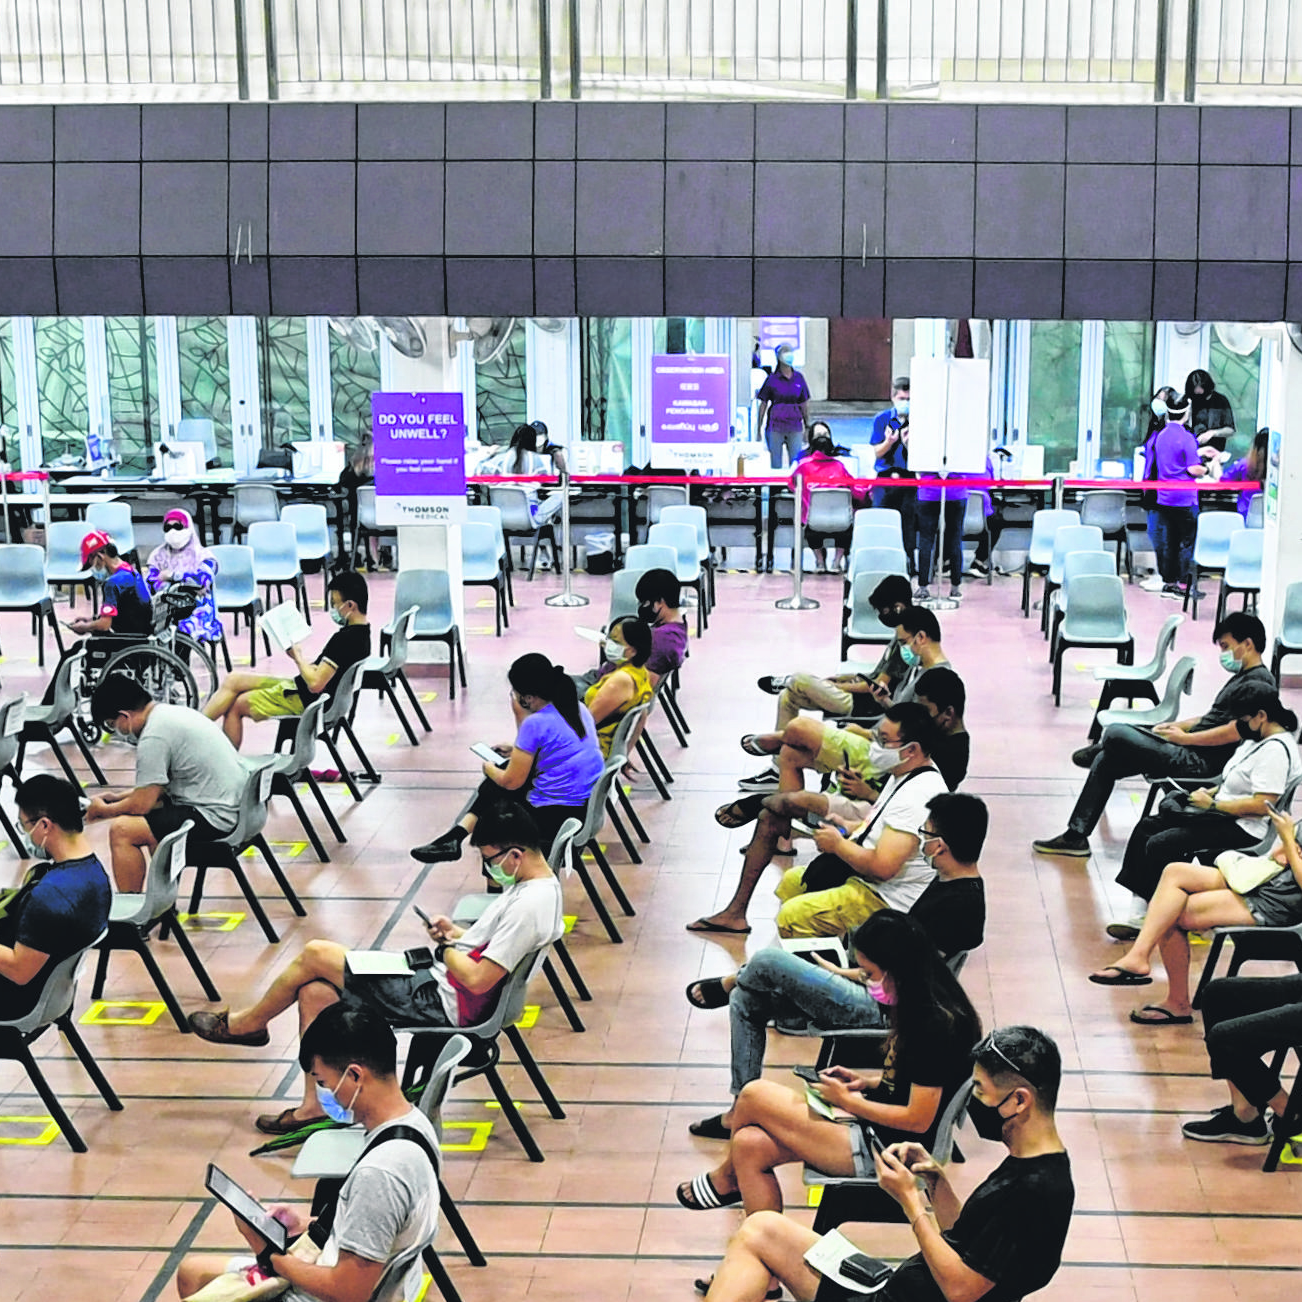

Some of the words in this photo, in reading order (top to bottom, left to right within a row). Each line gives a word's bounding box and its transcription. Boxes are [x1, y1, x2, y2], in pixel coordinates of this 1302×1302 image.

[378, 414, 397, 425] DO
[399, 414, 425, 425] YOU
[427, 414, 458, 425] FEEL
[390, 428, 448, 439] UNWELL?
